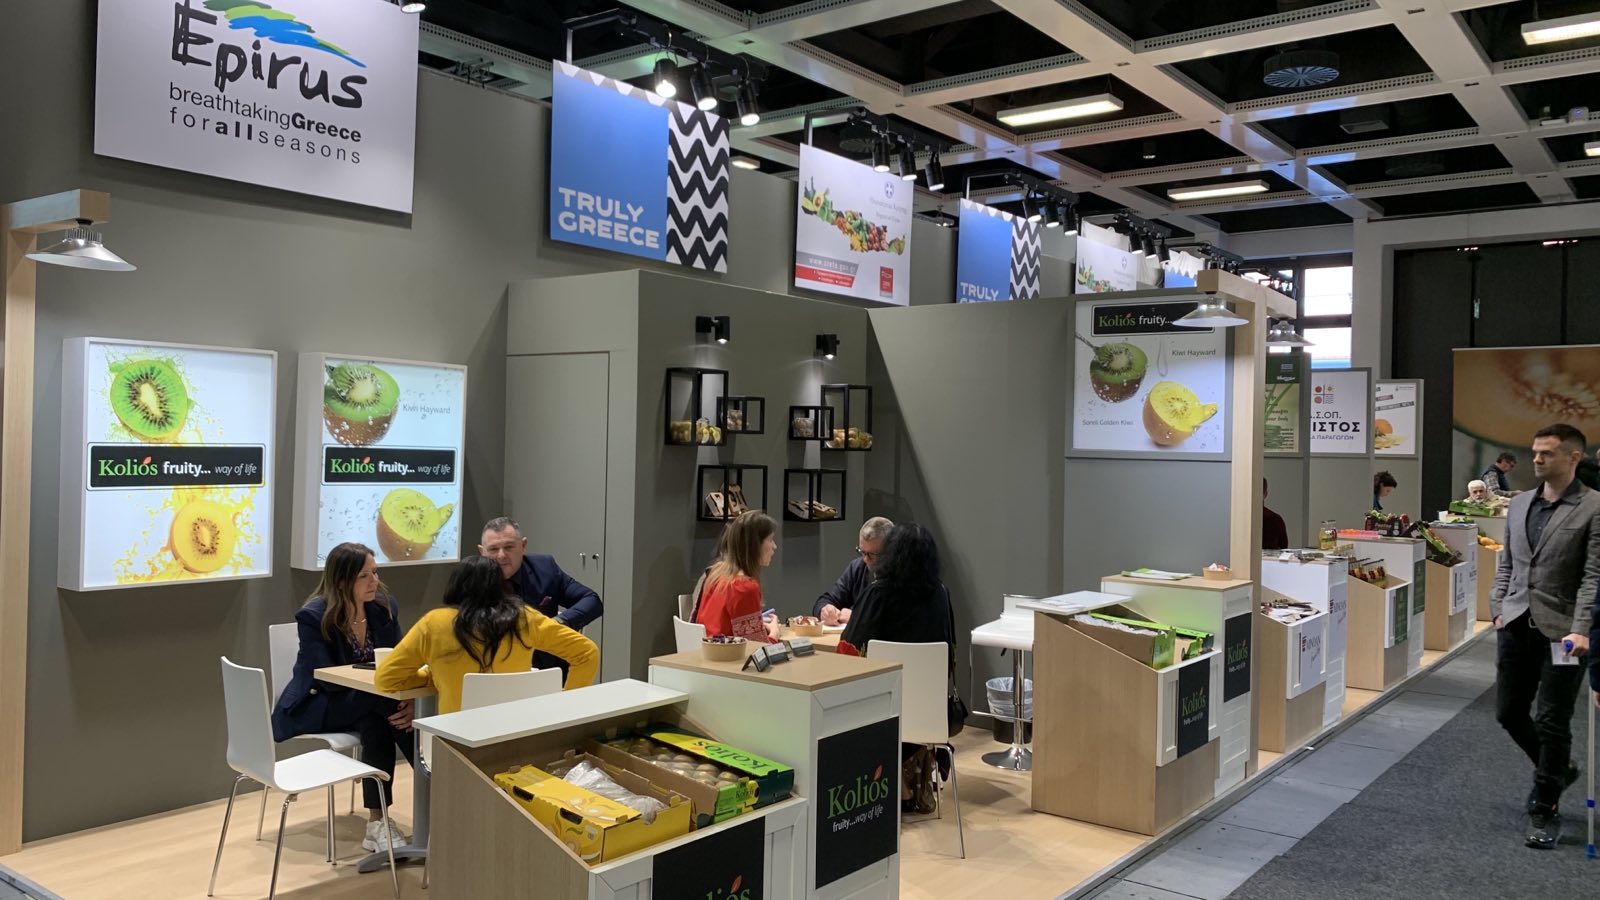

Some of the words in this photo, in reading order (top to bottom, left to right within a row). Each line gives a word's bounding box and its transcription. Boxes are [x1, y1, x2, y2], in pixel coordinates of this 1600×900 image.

[171, 0, 368, 109] Epirus
[558, 186, 644, 223] TRULY
[558, 211, 660, 249] GREECE
[960, 281, 999, 301] TRULY
[1099, 314, 1136, 328] Kolios
[1187, 349, 1216, 358] Hayward
[403, 404, 418, 412] Kiwi
[419, 404, 451, 415] Hayward
[98, 457, 158, 477] Kolios
[163, 460, 211, 477] fruity...
[215, 465, 233, 477] way
[234, 463, 243, 476] of
[244, 463, 257, 476] life
[330, 457, 375, 474] Kolios
[378, 460, 415, 476] fruity...
[417, 464, 431, 475] way
[432, 463, 440, 476] of
[440, 463, 451, 475] life
[1227, 642, 1249, 665] Kolios
[1182, 691, 1207, 717] Kolios
[694, 741, 768, 769] Kolios
[827, 770, 889, 819] Kolios
[867, 810, 875, 820] of
[874, 805, 884, 819] life
